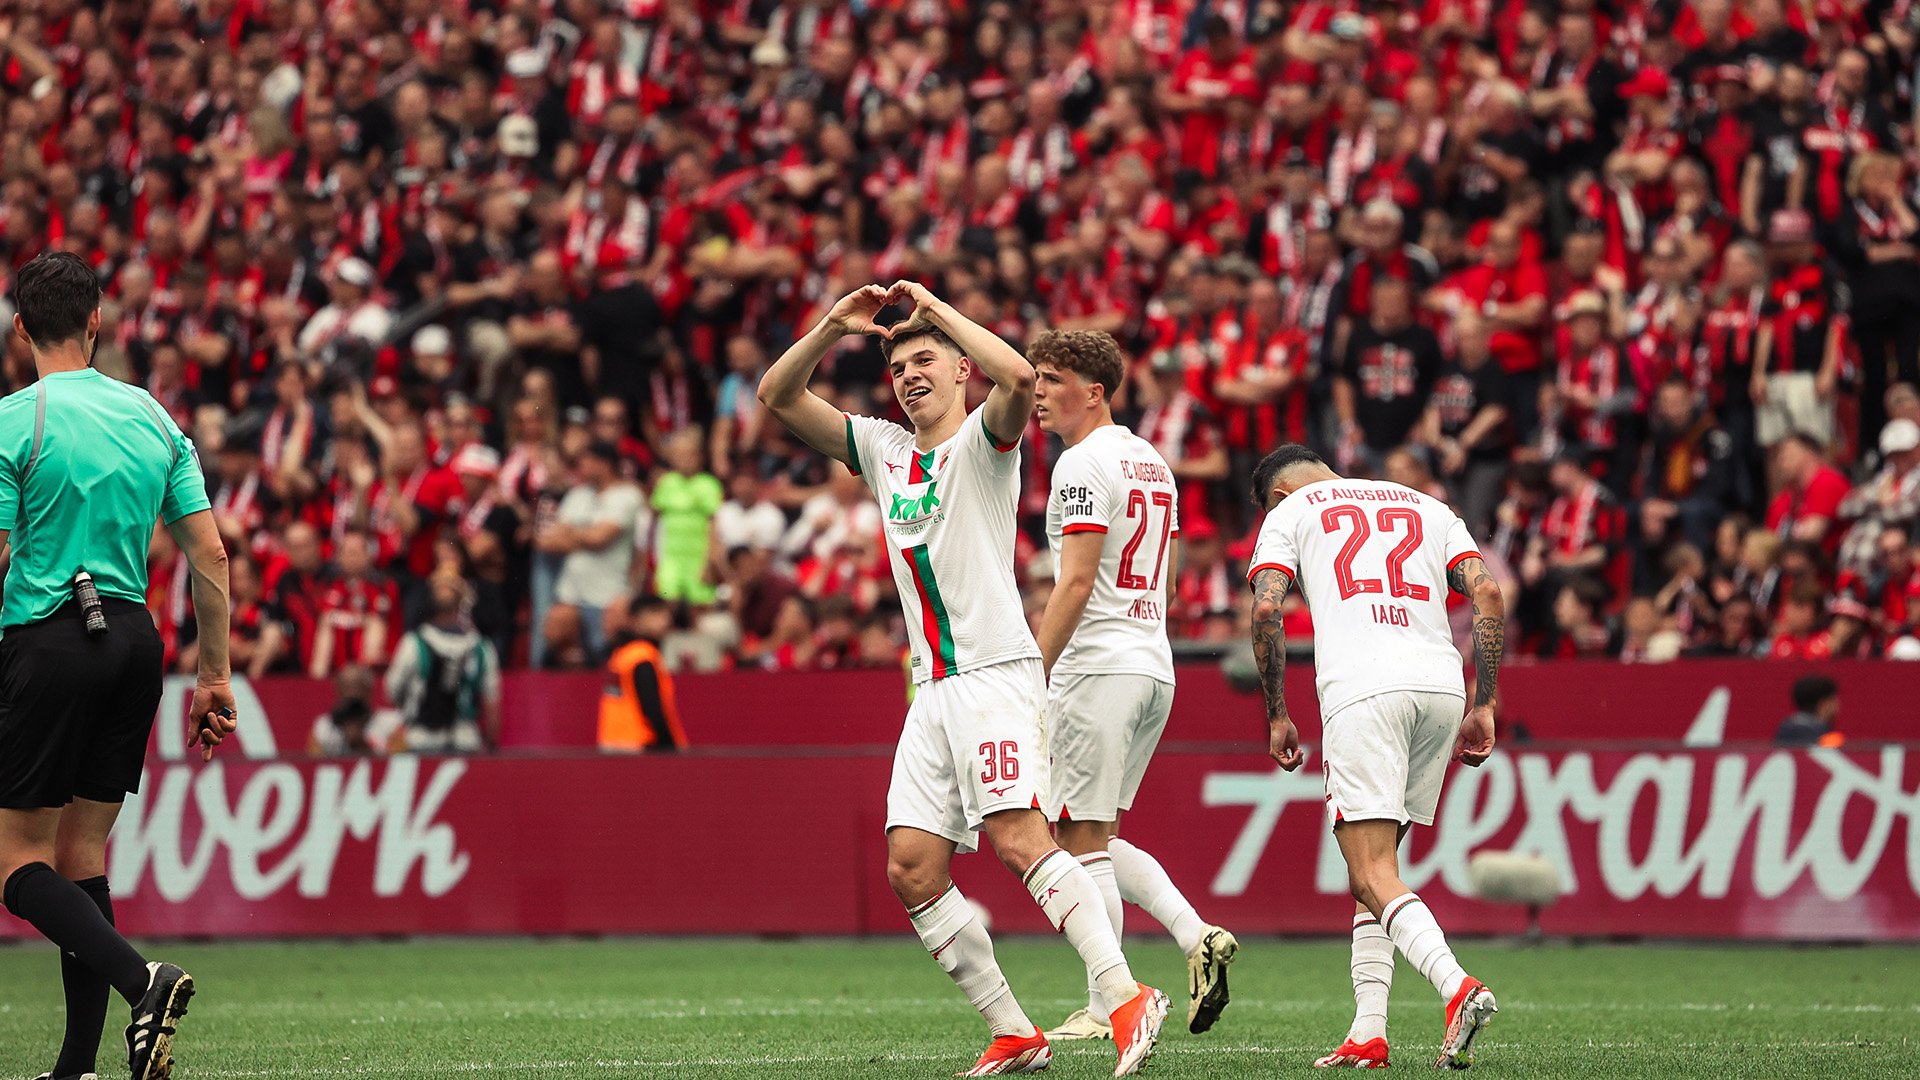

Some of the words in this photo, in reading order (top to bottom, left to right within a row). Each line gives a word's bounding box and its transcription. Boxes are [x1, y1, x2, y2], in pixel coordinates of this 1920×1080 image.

[1060, 484, 1093, 503] sieg-
[1306, 490, 1327, 505] FC
[1331, 488, 1421, 505] AUGSBURG
[1116, 489, 1172, 590] 27
[1321, 504, 1430, 601] 22
[1371, 604, 1409, 627] IAGO
[979, 741, 1019, 784] 36
